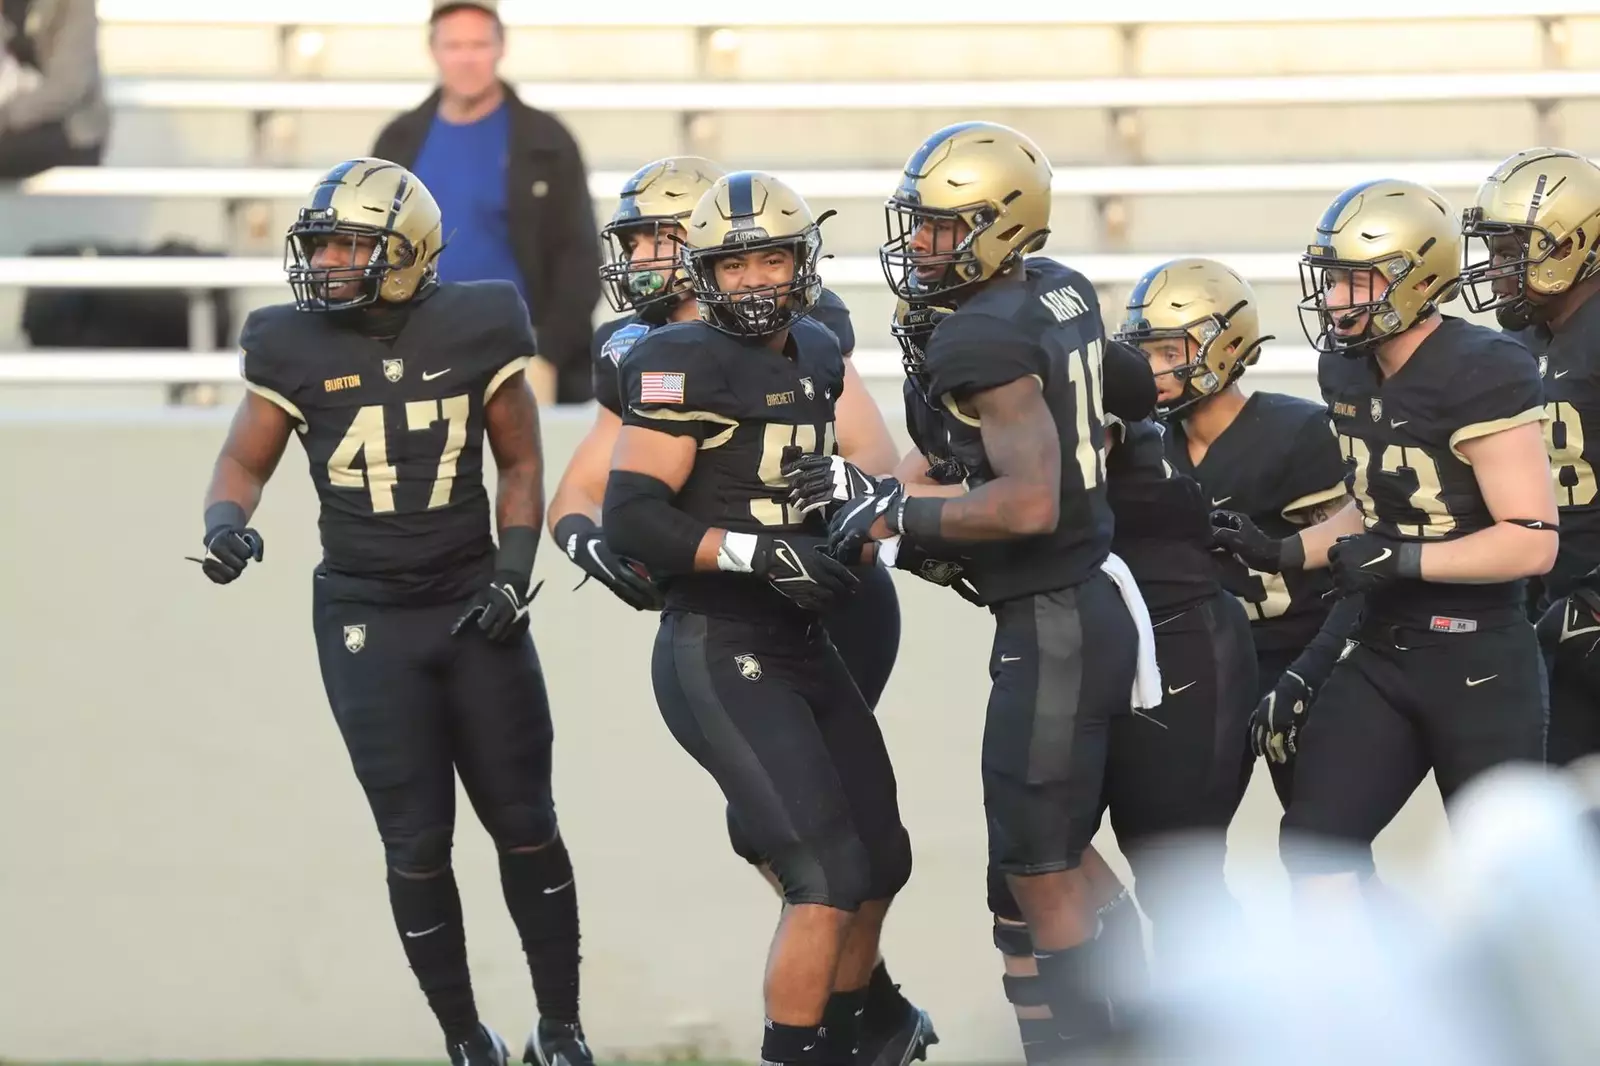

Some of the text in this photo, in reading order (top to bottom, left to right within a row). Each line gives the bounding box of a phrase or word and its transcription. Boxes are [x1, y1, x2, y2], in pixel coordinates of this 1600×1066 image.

[735, 231, 757, 242] ARMY
[1040, 285, 1089, 323] ARMY
[324, 374, 361, 393] BURTON
[766, 391, 795, 406] BIRCHETT
[327, 393, 470, 514] 47
[749, 421, 837, 526] 9
